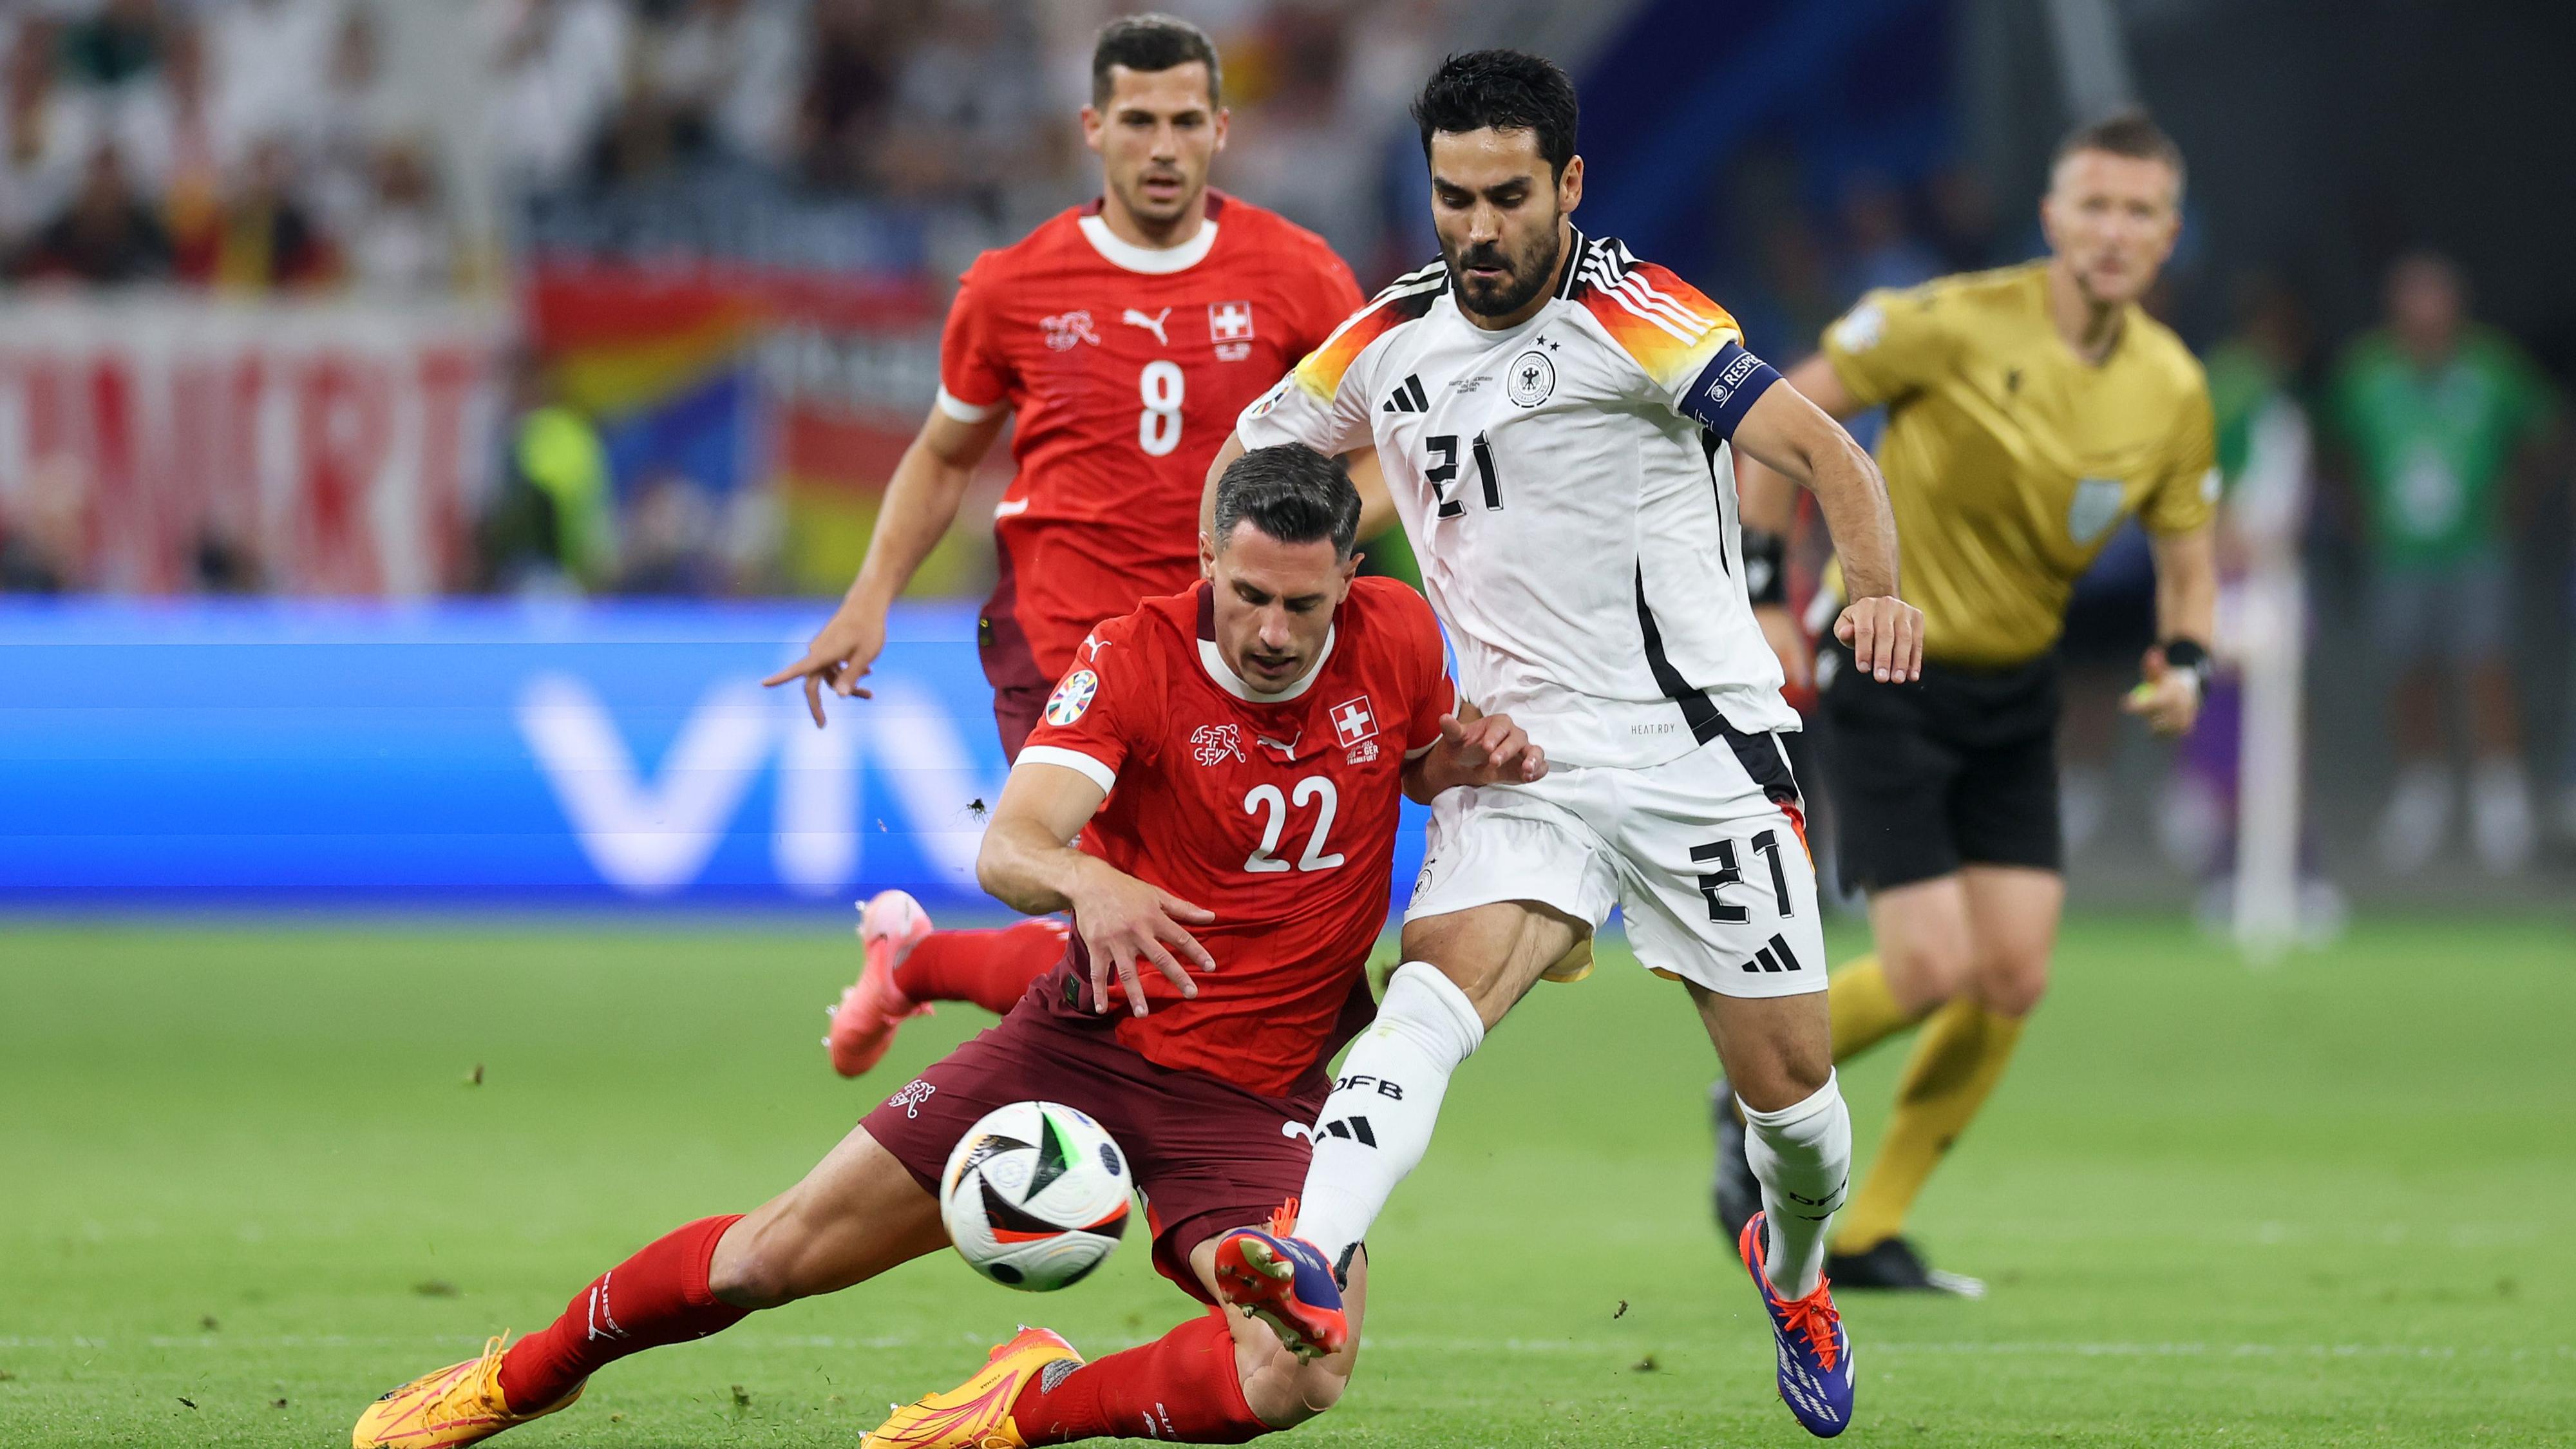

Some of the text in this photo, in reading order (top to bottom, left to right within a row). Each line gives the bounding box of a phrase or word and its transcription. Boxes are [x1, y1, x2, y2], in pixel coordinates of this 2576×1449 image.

[1139, 359, 1184, 456] 8
[1425, 430, 1504, 520] 21
[1364, 744, 1379, 755] GER
[1243, 775, 1345, 873] 22
[1689, 829, 1795, 925] 21
[1331, 1075, 1403, 1101] DFB
